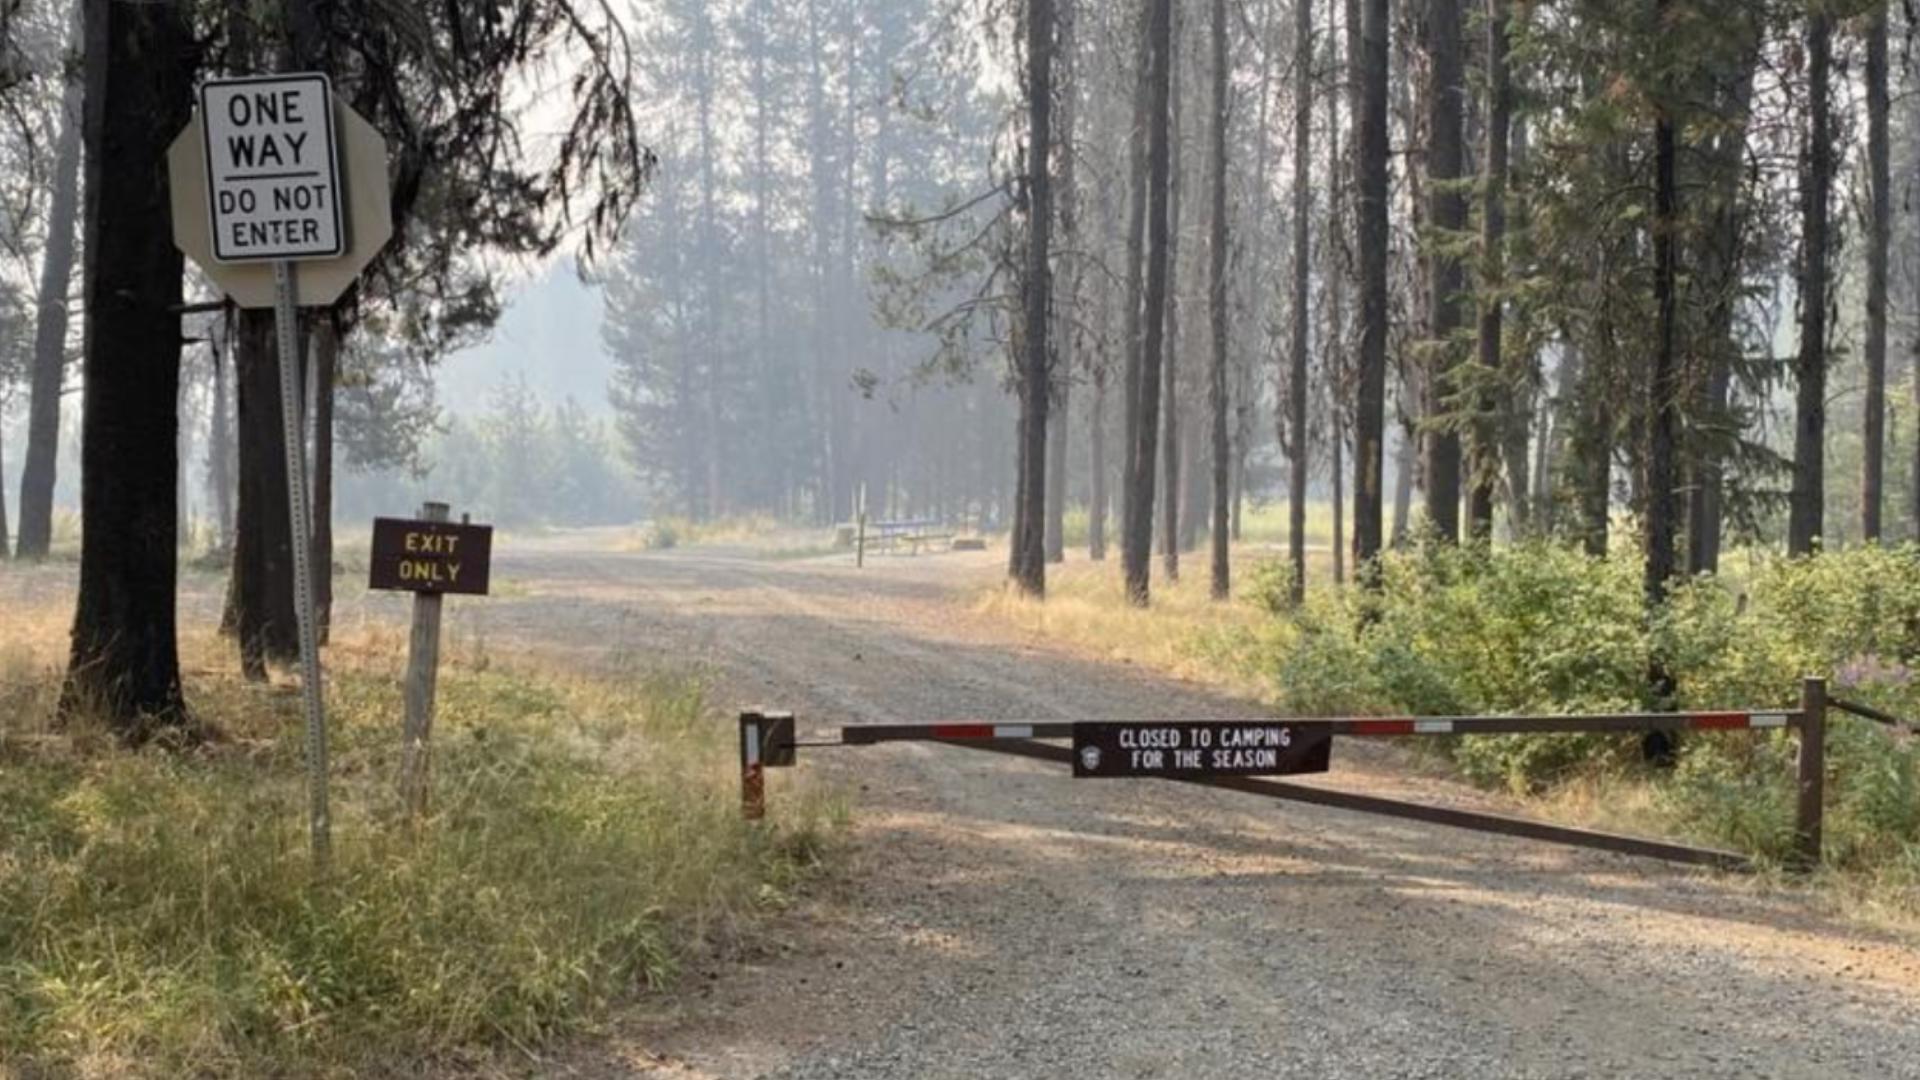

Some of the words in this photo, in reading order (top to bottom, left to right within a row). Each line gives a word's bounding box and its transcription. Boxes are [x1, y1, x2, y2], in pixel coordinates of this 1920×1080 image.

[228, 91, 304, 127] ONE
[227, 131, 308, 168] WAY
[219, 188, 256, 214] DO
[273, 185, 327, 212] NOT
[232, 218, 319, 247] ENTER
[405, 532, 459, 553] EXIT
[399, 560, 461, 581] ONLY
[1119, 729, 1181, 748] CLOSED
[1190, 729, 1212, 747] TO
[1220, 728, 1291, 746] CAMPING
[1131, 750, 1163, 768] FOR
[1175, 750, 1202, 768] THE
[1212, 750, 1277, 768] SEASON
